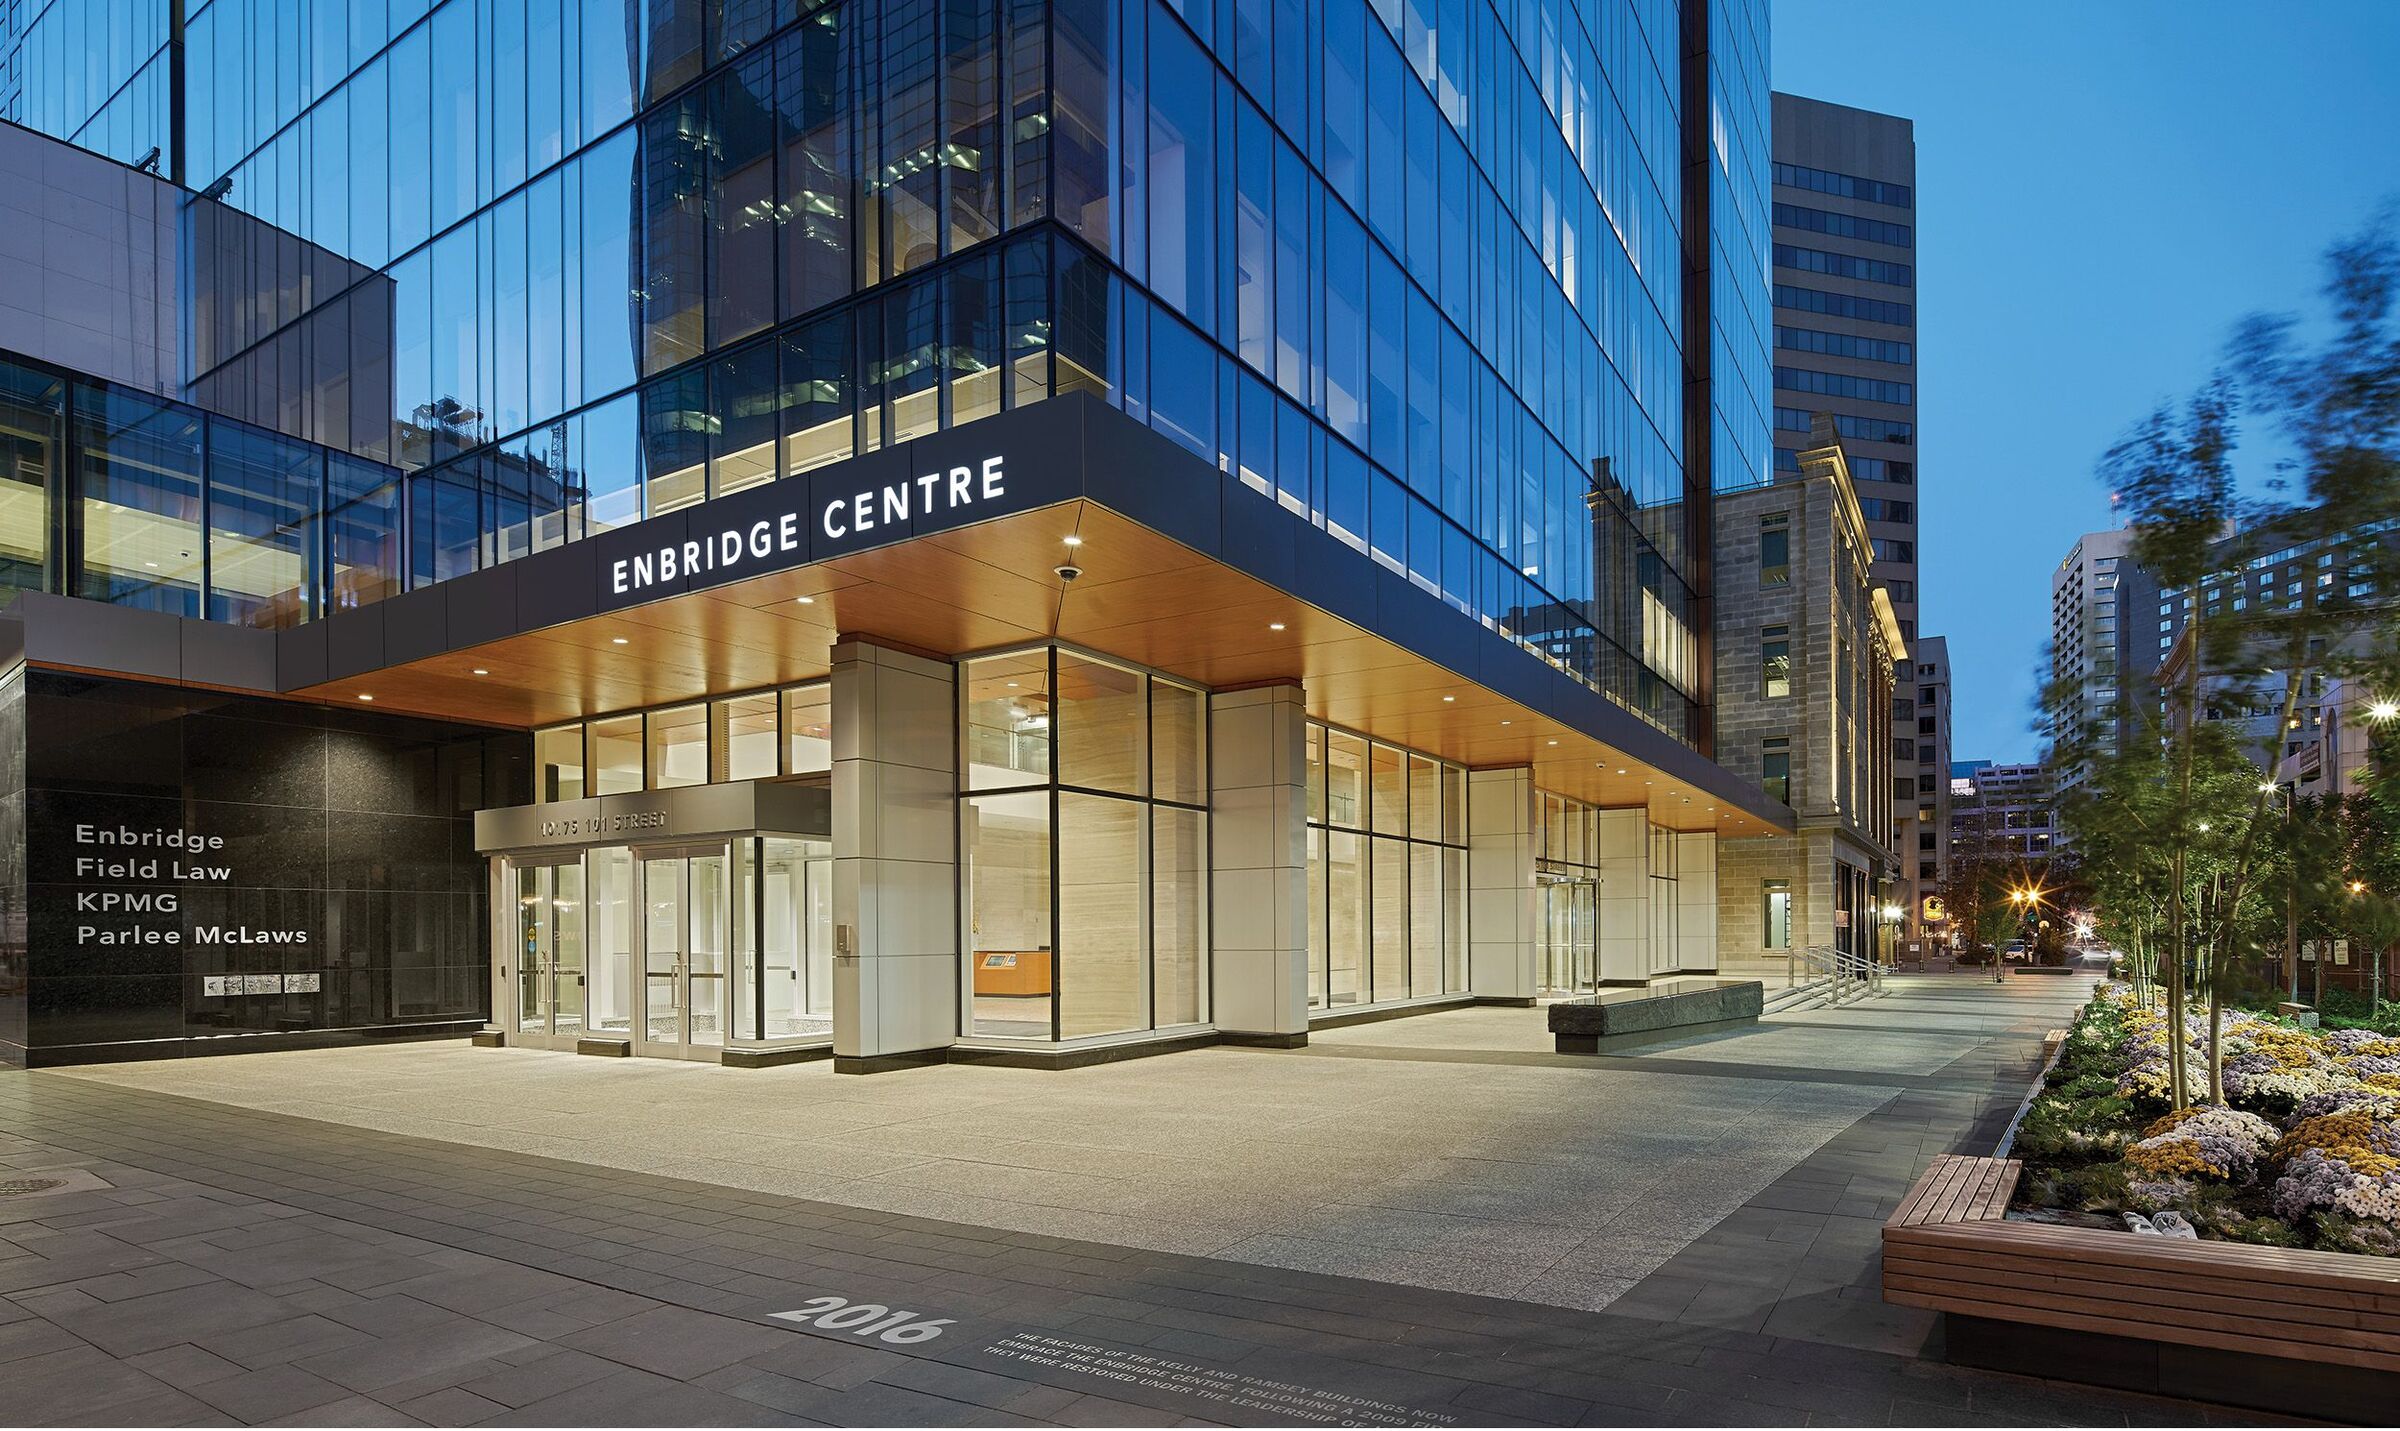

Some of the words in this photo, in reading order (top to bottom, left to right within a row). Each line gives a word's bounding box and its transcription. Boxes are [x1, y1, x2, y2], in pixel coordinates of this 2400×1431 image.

[613, 512, 799, 594] ENBRIDGE
[823, 455, 1006, 539] CENTRE
[76, 824, 225, 854] Enbridge
[585, 817, 607, 833] 101
[614, 811, 667, 831] STREET
[76, 858, 158, 880] Field
[173, 860, 232, 881] Law
[77, 892, 179, 913] KPMG
[78, 925, 182, 945] Parlee
[195, 926, 309, 945] McLaws
[765, 1296, 958, 1344] 2016
[983, 1346, 1020, 1358] THEY
[1019, 1352, 1063, 1367] WERE
[1060, 1362, 1137, 1383] RESTORED
[1139, 1378, 1194, 1394] UNDER
[1196, 1390, 1229, 1402] THE
[1230, 1396, 1338, 1423] LEADERSHIP
[1341, 1418, 1367, 1428] OF
[997, 1339, 1066, 1357] EMBRACE
[1066, 1352, 1095, 1363] THE
[1094, 1357, 1169, 1378] ENBRIDGE
[1240, 1386, 1338, 1412] FOLLOWING
[1341, 1407, 1355, 1416] A
[1358, 1410, 1407, 1426] 2009
[1015, 1332, 1041, 1342] THE
[1040, 1337, 1104, 1354] FACADES
[1104, 1350, 1127, 1358] OF
[1123, 1353, 1157, 1364] THE
[1156, 1359, 1204, 1374] KELLY
[1203, 1369, 1239, 1381] AND
[1241, 1376, 1314, 1395] RAMSEY
[1313, 1390, 1409, 1414] BUILDINGS
[1411, 1409, 1458, 1424] NOW
